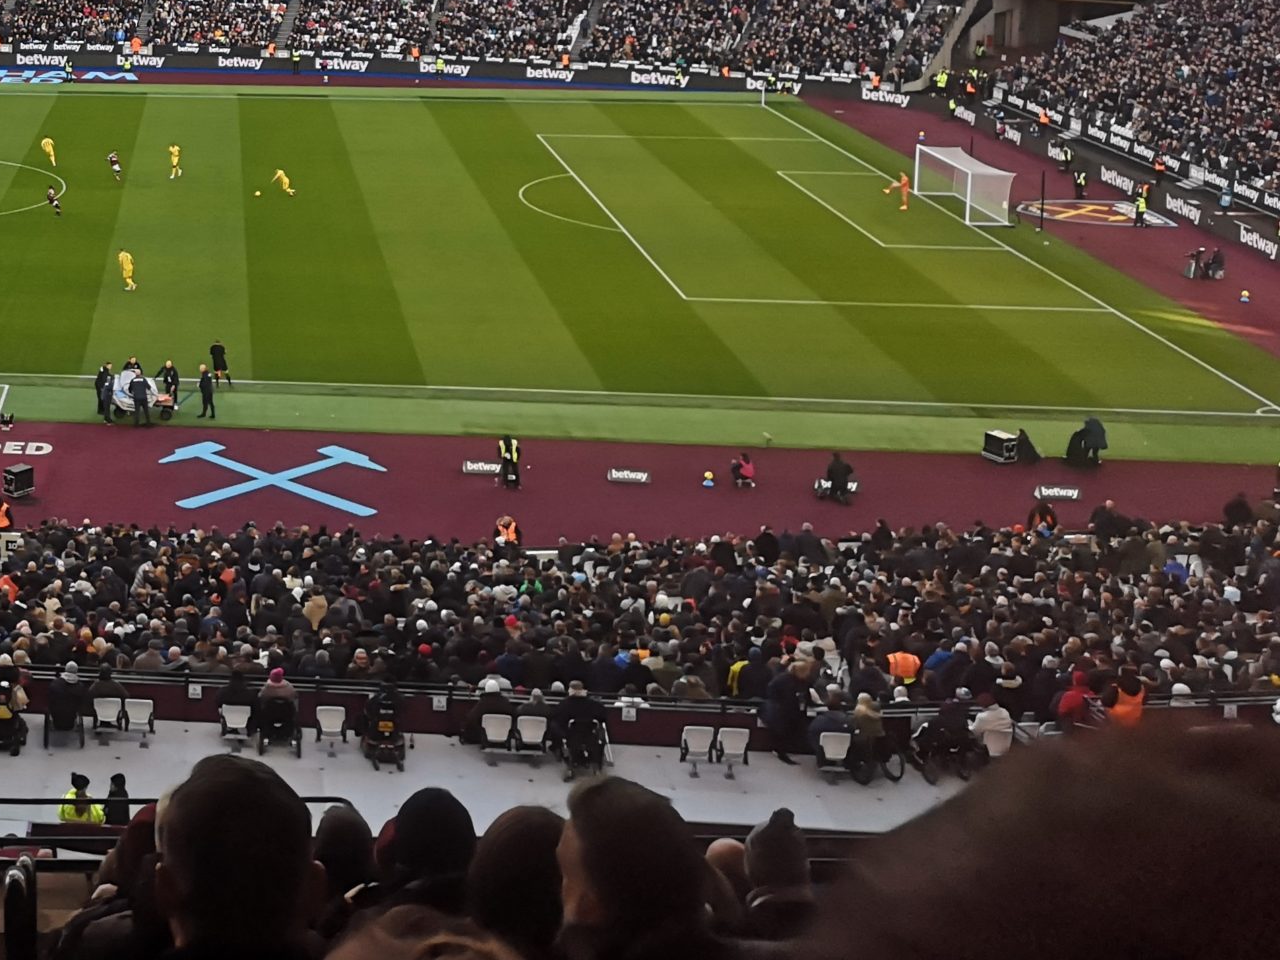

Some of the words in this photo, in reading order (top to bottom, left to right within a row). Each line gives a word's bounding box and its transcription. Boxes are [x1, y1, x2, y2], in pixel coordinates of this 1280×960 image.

[20, 42, 48, 52] betway
[54, 42, 81, 52] betway
[87, 43, 114, 53] betway
[16, 54, 68, 66] betway
[218, 56, 264, 70] betway
[420, 62, 470, 76] beway
[526, 66, 575, 82] betway
[862, 88, 910, 108] betway
[1100, 165, 1134, 196] betway
[1234, 180, 1260, 203] betway
[1264, 192, 1280, 210] betw
[1166, 193, 1202, 225] betway
[1240, 225, 1279, 260] betway
[466, 461, 502, 473] betway
[611, 468, 648, 482] betway
[1041, 486, 1079, 498] betway
[8, 542, 18, 550] 10
